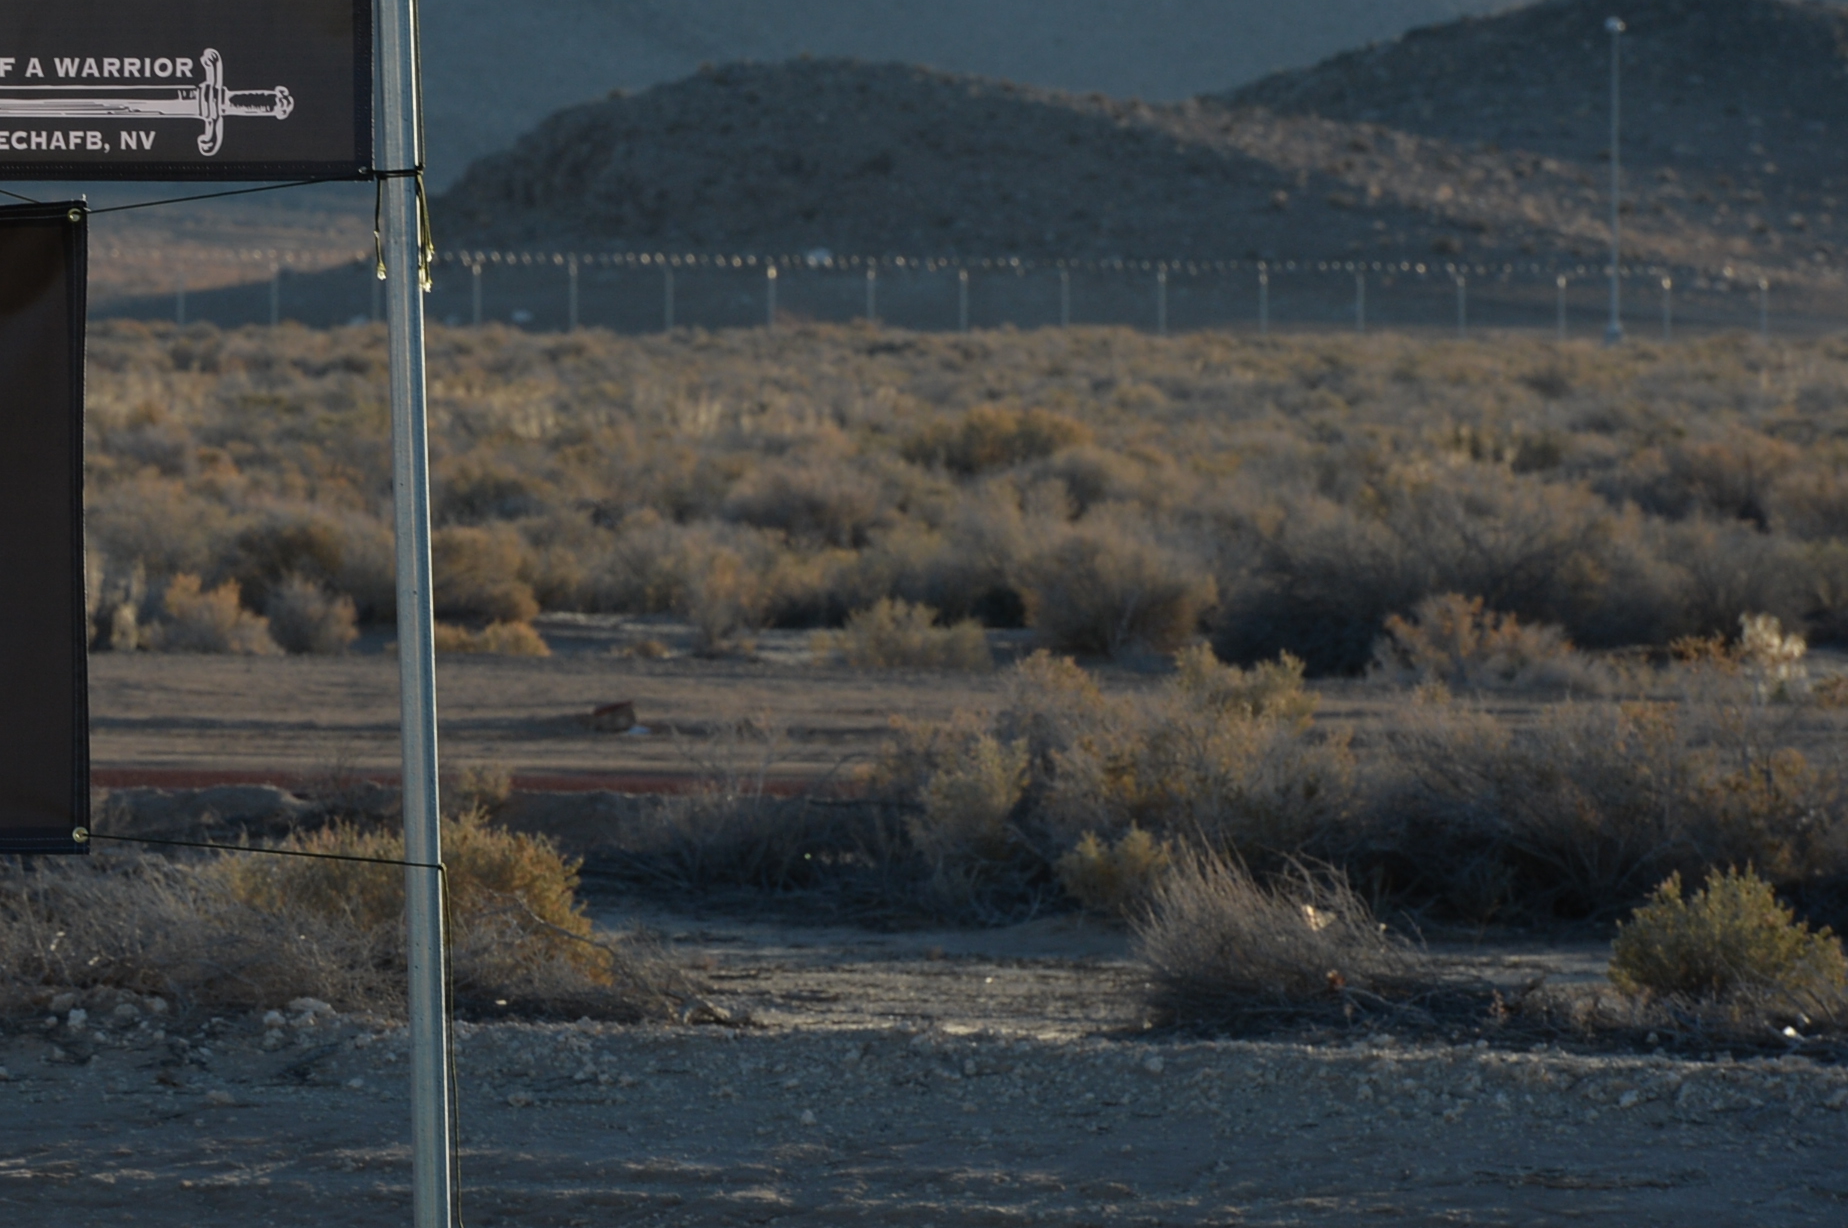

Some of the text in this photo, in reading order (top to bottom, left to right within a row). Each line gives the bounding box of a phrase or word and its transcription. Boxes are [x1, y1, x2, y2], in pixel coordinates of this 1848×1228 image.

[25, 57, 44, 77] A
[54, 57, 193, 77] WARRIOR
[120, 131, 156, 150] NV
